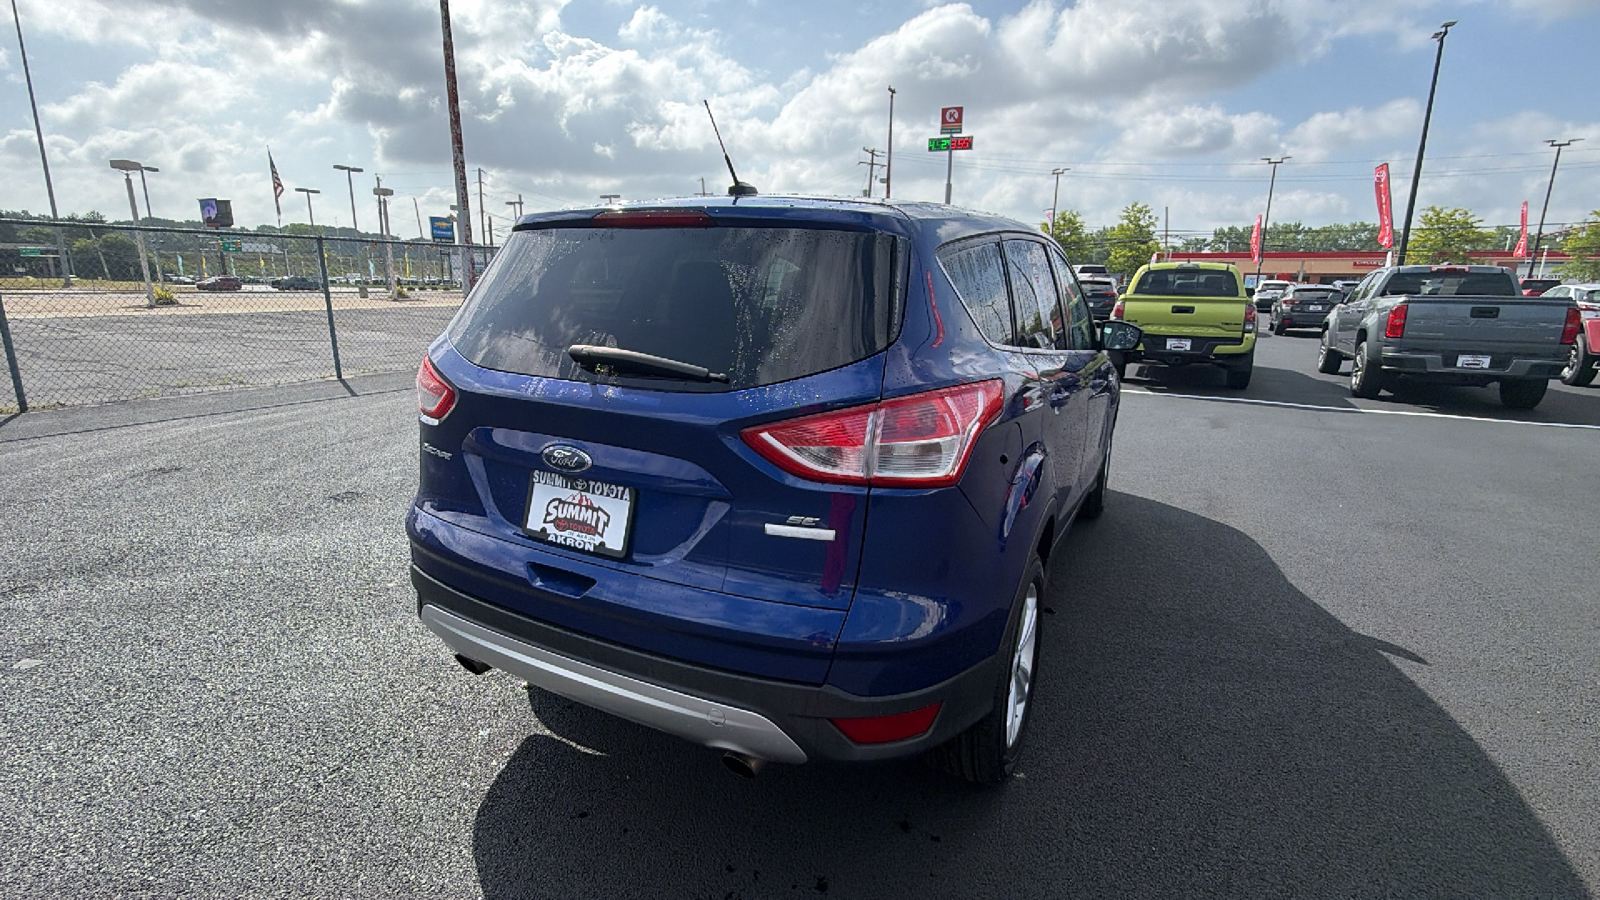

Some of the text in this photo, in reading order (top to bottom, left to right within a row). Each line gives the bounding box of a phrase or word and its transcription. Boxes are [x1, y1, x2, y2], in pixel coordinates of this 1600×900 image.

[947, 110, 958, 122] K
[550, 449, 579, 467] Ford
[532, 469, 631, 501] SUMMIT TOYOTA
[546, 500, 609, 535] SUMMIT
[786, 515, 820, 526] SE
[569, 522, 595, 534] TOYOTA
[547, 533, 594, 552] AKRON
